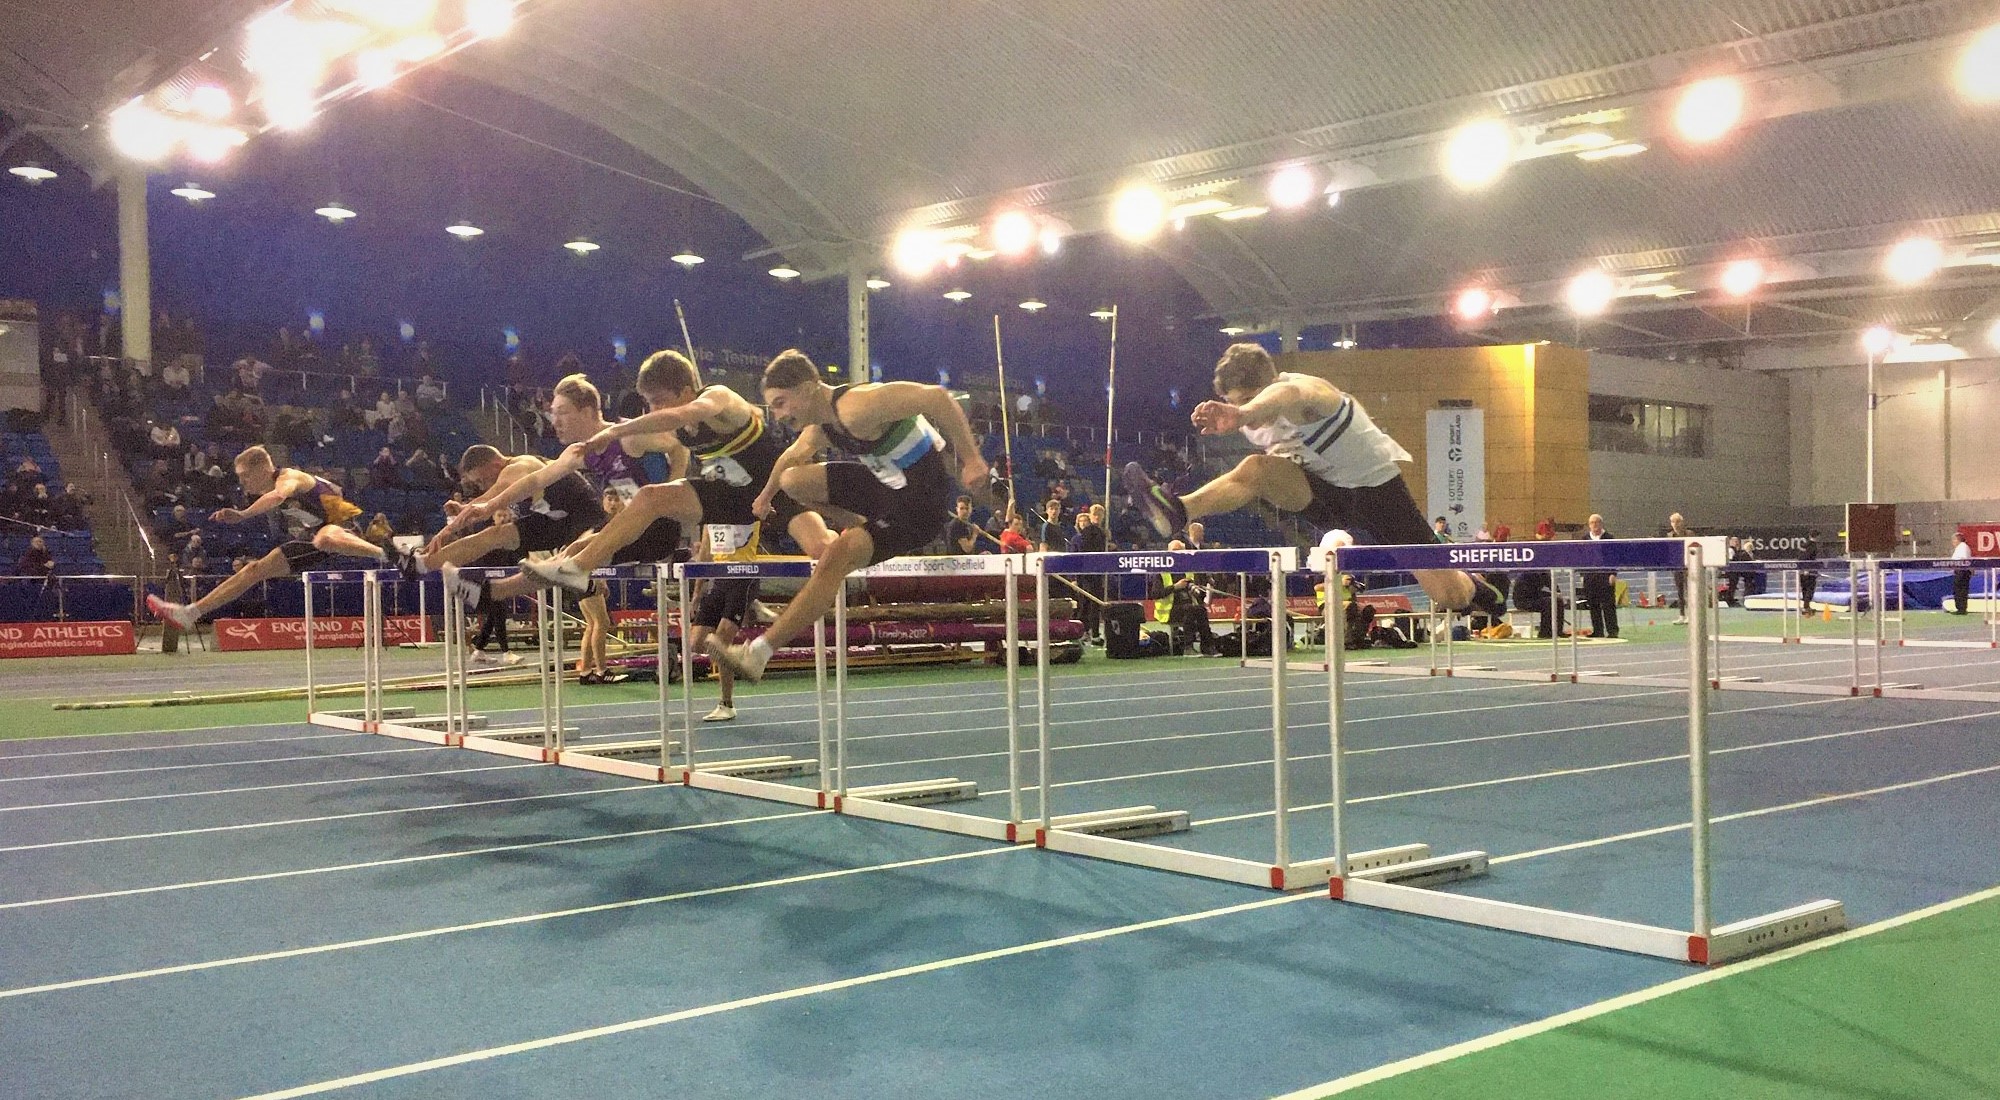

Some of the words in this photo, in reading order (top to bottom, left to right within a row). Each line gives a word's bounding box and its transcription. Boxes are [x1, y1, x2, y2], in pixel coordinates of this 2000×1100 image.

[1456, 468, 1464, 501] FUNDED
[713, 531, 726, 543] 52
[1118, 556, 1175, 568] SHEFFIELD
[1449, 547, 1535, 563] SHEFFIELD
[727, 565, 759, 574] SHEFFIELD
[882, 560, 912, 572] Institute
[914, 559, 922, 571] of
[923, 559, 945, 574] Sport
[952, 558, 985, 571] Sheffield
[350, 618, 422, 632] ATETICS
[33, 625, 123, 640] ATHLETICS
